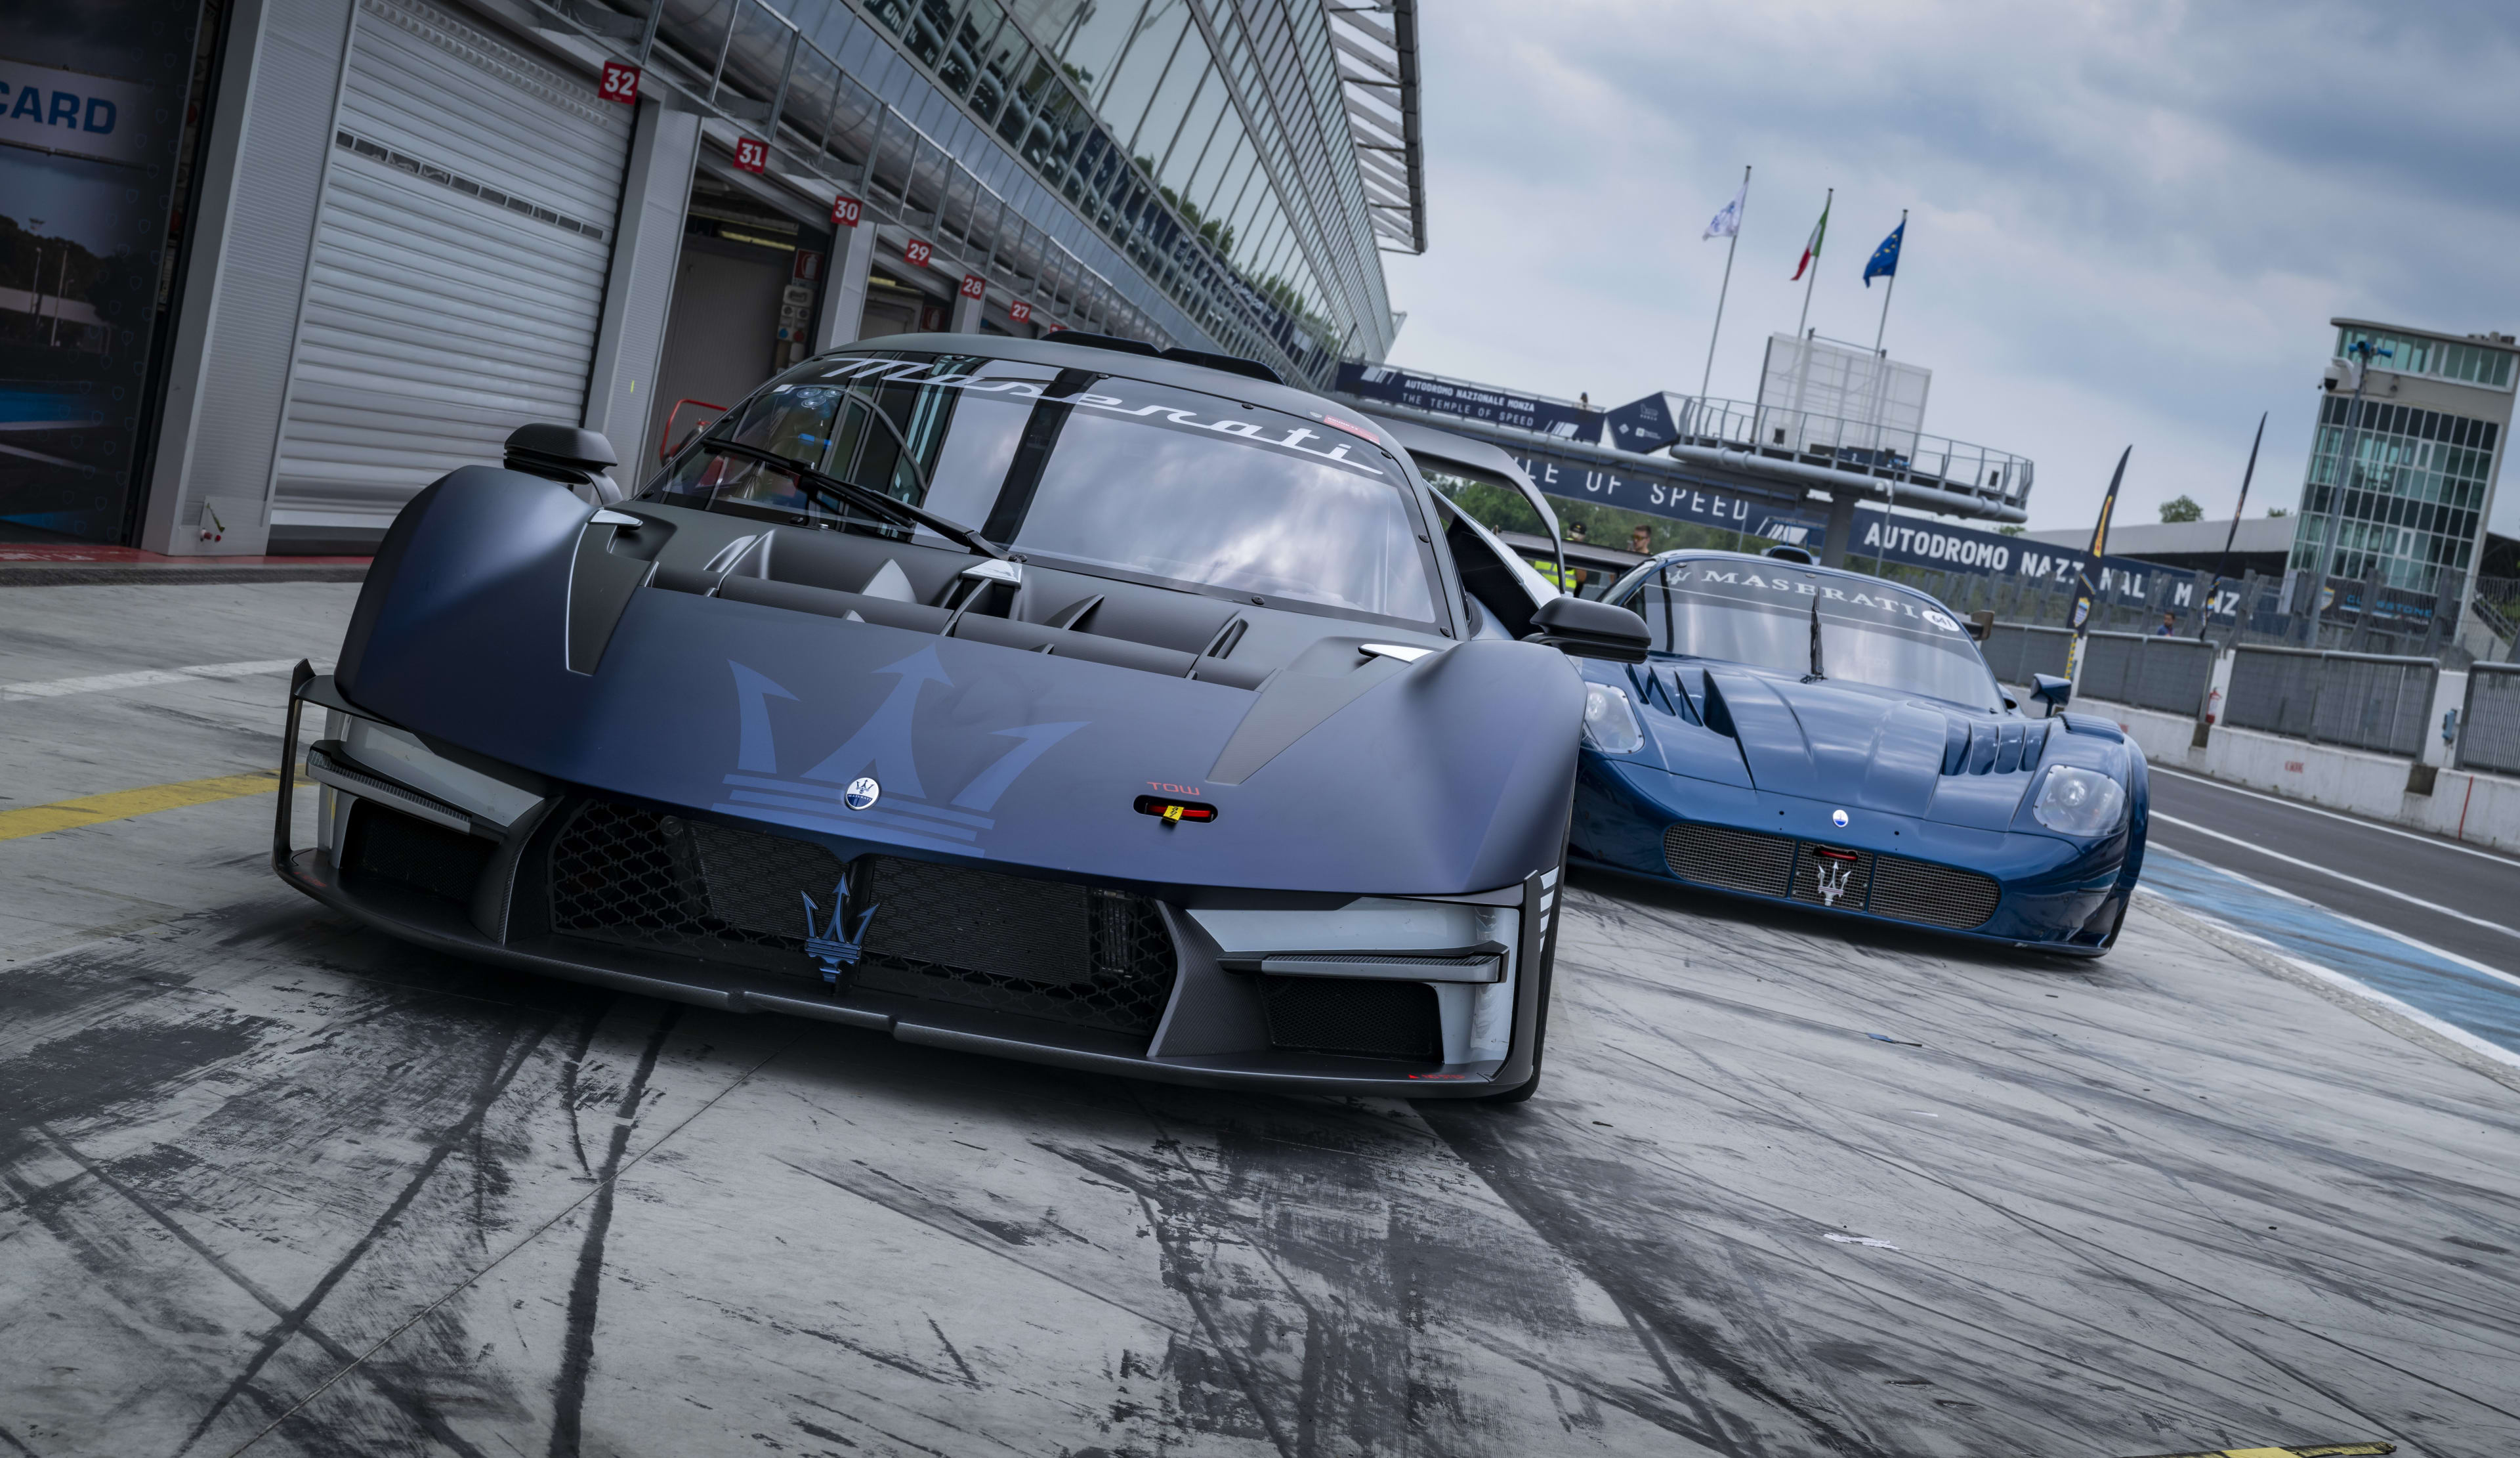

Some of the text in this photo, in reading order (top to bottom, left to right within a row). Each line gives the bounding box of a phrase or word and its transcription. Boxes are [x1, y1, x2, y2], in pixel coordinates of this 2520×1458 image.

[604, 68, 635, 96] 32
[739, 142, 763, 167] 31
[835, 200, 859, 221] 30
[908, 243, 929, 261] 29
[963, 278, 982, 295] 28
[1012, 304, 1030, 319] 27
[1404, 379, 1536, 412] AUTODROMO NAZIONALE MONZA
[1402, 393, 1534, 427] THE TEMPLE OF SPEED
[1650, 483, 1748, 521] SPEED
[1864, 522, 2009, 571] AUTODROMO
[1701, 570, 1920, 619] MASERATI
[1146, 781, 1200, 796] TOW
